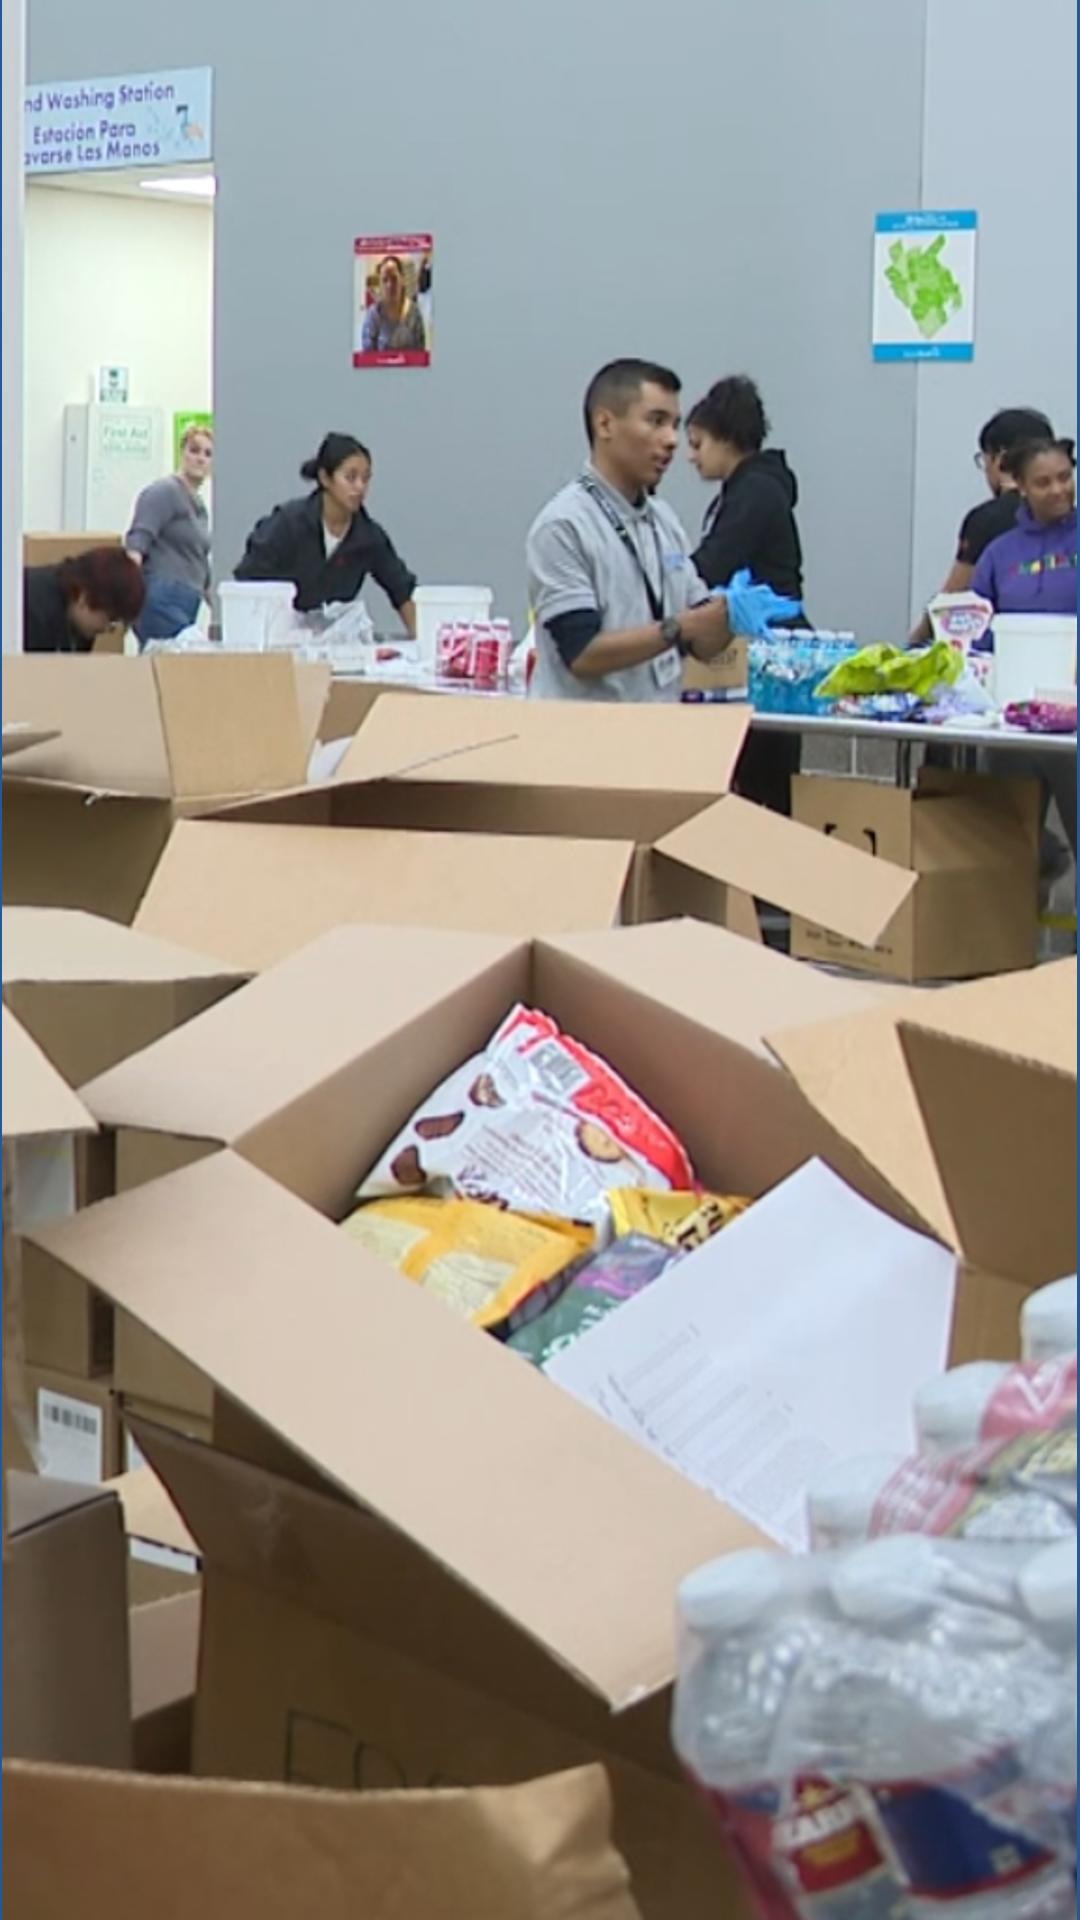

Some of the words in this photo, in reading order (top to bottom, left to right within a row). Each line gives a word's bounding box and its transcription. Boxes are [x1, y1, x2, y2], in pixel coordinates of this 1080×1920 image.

[24, 92, 42, 112] nd
[48, 88, 115, 110] Washing
[118, 81, 174, 105] Station
[100, 119, 136, 138] Para
[24, 149, 73, 166] avarse
[77, 144, 101, 162] Las
[106, 141, 160, 160] Manos
